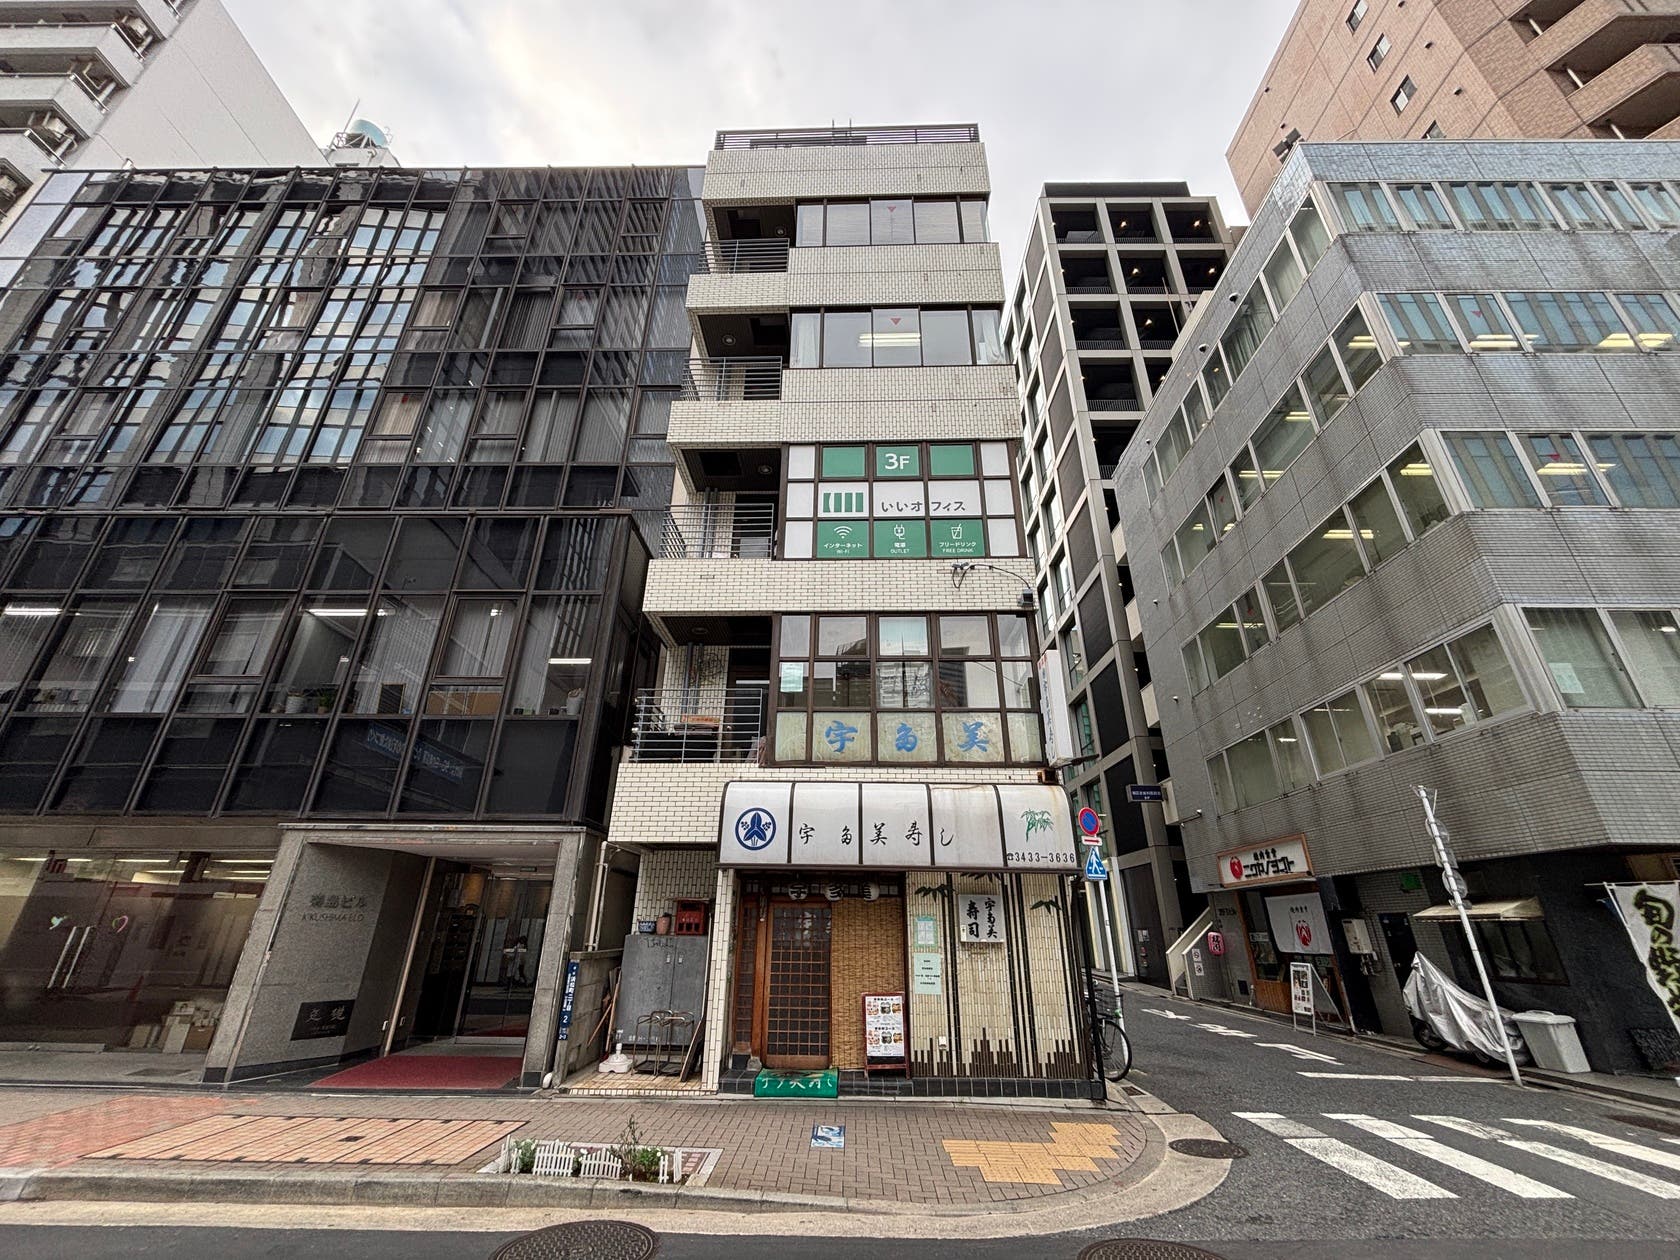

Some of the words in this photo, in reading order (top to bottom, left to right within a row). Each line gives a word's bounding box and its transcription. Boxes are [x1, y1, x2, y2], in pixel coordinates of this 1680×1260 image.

[885, 453, 910, 470] 3F
[881, 501, 966, 512] いいオフィス
[966, 899, 980, 939] 寿司
[563, 1015, 568, 1023] 2
